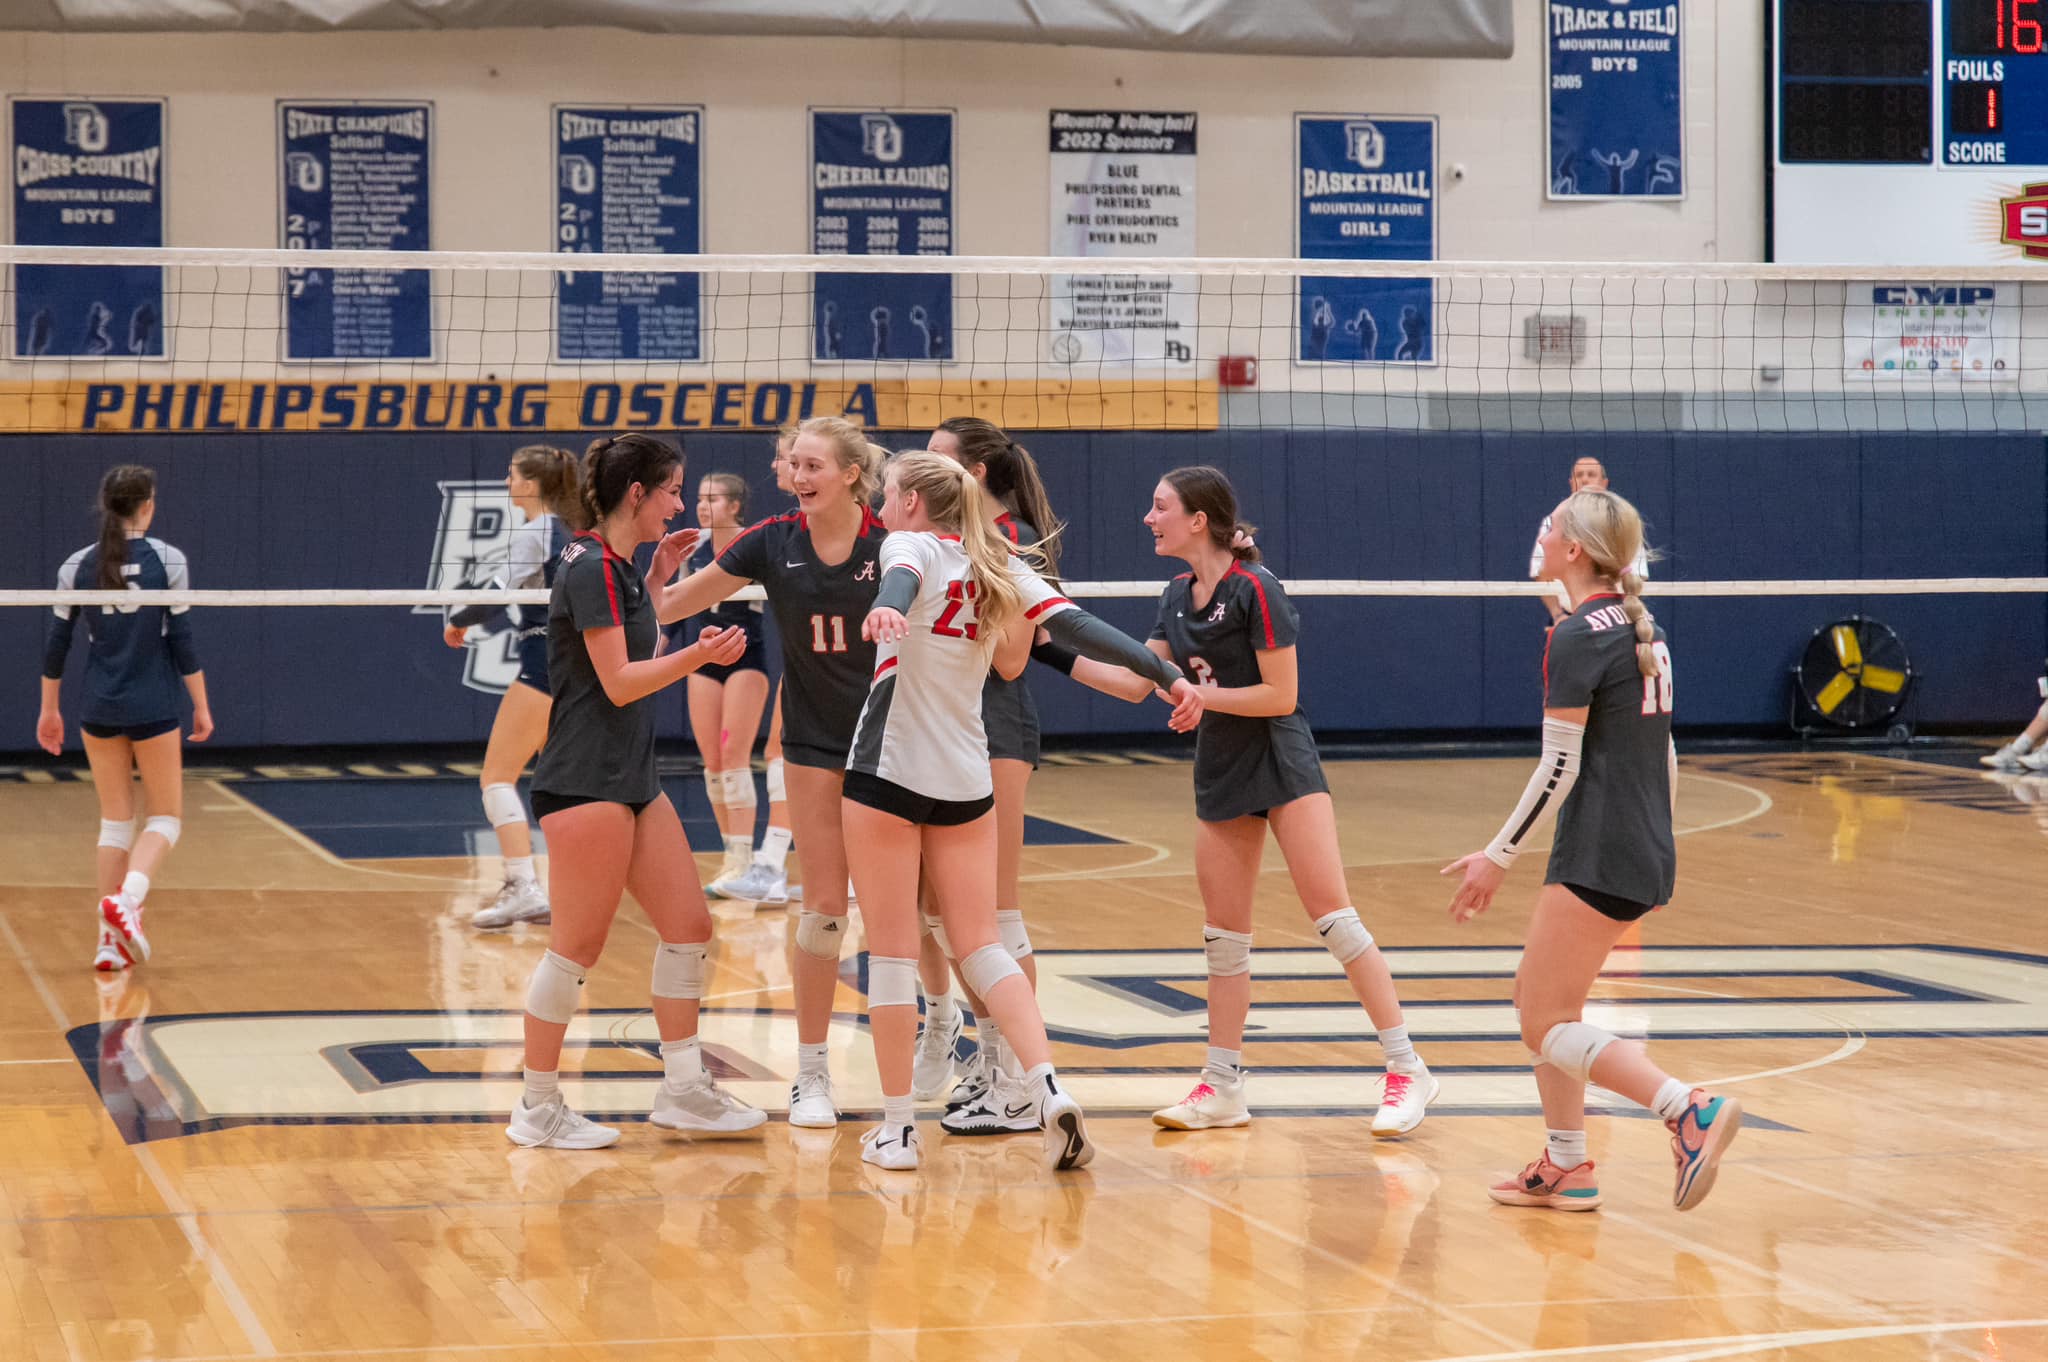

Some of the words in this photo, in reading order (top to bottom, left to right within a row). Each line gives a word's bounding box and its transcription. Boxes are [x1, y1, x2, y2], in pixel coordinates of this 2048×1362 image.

[1551, 3, 1609, 36] TRACK
[1613, 10, 1626, 29] &
[1628, 4, 1677, 36] FIELD
[1996, 0, 2042, 53] 16
[1558, 38, 1623, 51] MOUNTAIN
[1625, 39, 1671, 52] LEAGUE
[1591, 57, 1638, 72] BOYS
[1947, 61, 2004, 81] FOULS
[1552, 74, 1583, 89] 2005
[1987, 88, 1997, 128] 1
[288, 109, 333, 140] STATE
[336, 109, 424, 140] CHAMPIONS
[562, 112, 606, 142] STATE
[609, 113, 696, 145] CHAMPIONS
[1052, 113, 1115, 129] Mountie
[1118, 113, 1195, 135] Volleyball
[330, 134, 383, 149] Softball
[603, 138, 656, 152] Softball
[1058, 132, 1103, 149] 2022
[1103, 132, 1175, 151] Sponsors
[1949, 142, 2006, 163] SCORE
[17, 145, 160, 187] CROSS-COUNTRY
[1107, 164, 1139, 178] BLUE
[816, 162, 950, 192] CHEERLEADING
[1303, 167, 1431, 199] BASKETBALL
[25, 188, 99, 201] MOUNTAIN
[101, 189, 152, 203] LEAGUE
[1065, 183, 1139, 196] PHILIPSBURG
[1142, 184, 1182, 197] DENTAL
[823, 197, 893, 210] MOUNTAIN
[895, 197, 942, 210] LEAGUE
[1096, 197, 1152, 209] PARTNERS
[1310, 202, 1376, 215] MOUNTAIN
[1378, 203, 1425, 216] LEAGUE
[61, 208, 115, 224] BOYS
[1095, 214, 1179, 227] ORTHODONTICS
[1340, 221, 1391, 236] GIRLS
[1119, 232, 1158, 244] REALTY
[1878, 308, 1989, 318] ENERGY
[82, 384, 551, 430] PHILIPSBURG
[810, 614, 848, 652] 11
